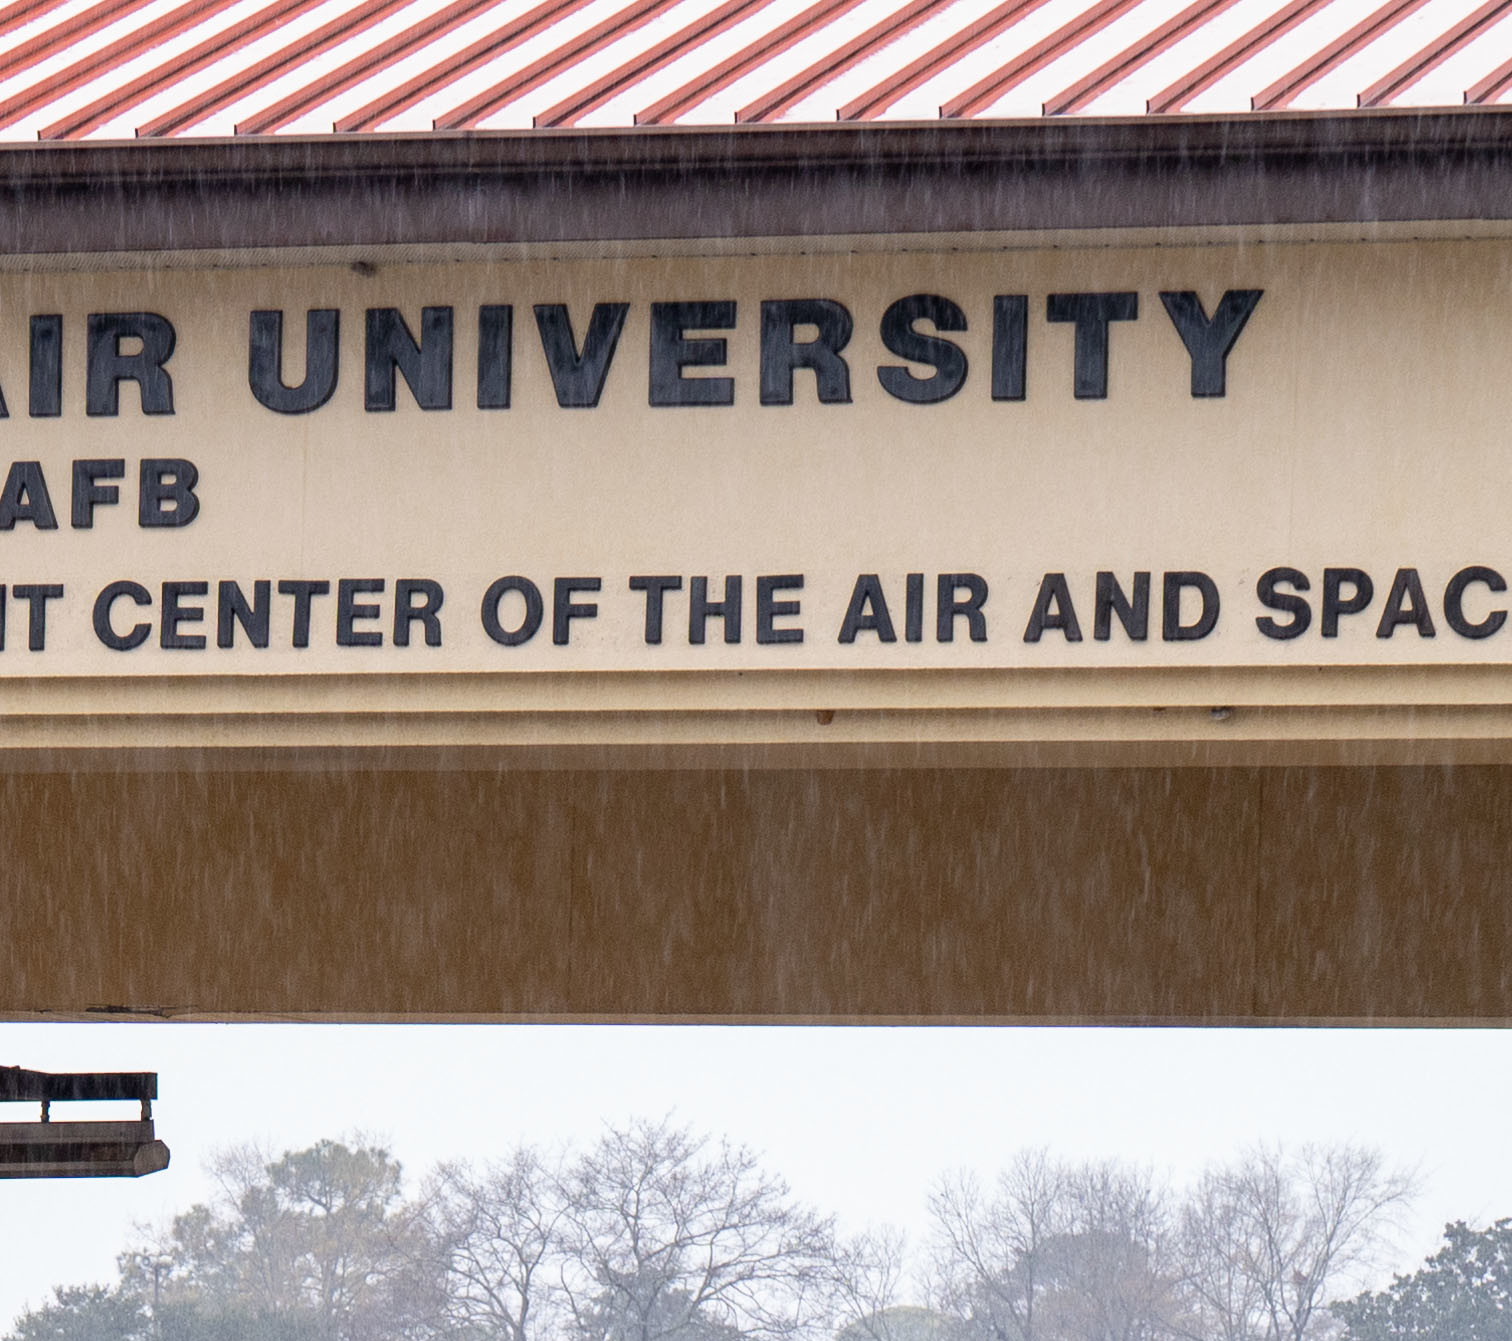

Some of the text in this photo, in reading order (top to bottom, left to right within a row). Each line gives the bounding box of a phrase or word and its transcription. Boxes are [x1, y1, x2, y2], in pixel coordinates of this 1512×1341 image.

[249, 289, 1267, 416] UNIVERSITY
[92, 578, 444, 652] CENTER
[481, 575, 602, 647] OF
[628, 574, 804, 646] THE
[837, 573, 989, 644] AIR
[1023, 571, 1221, 643] AND
